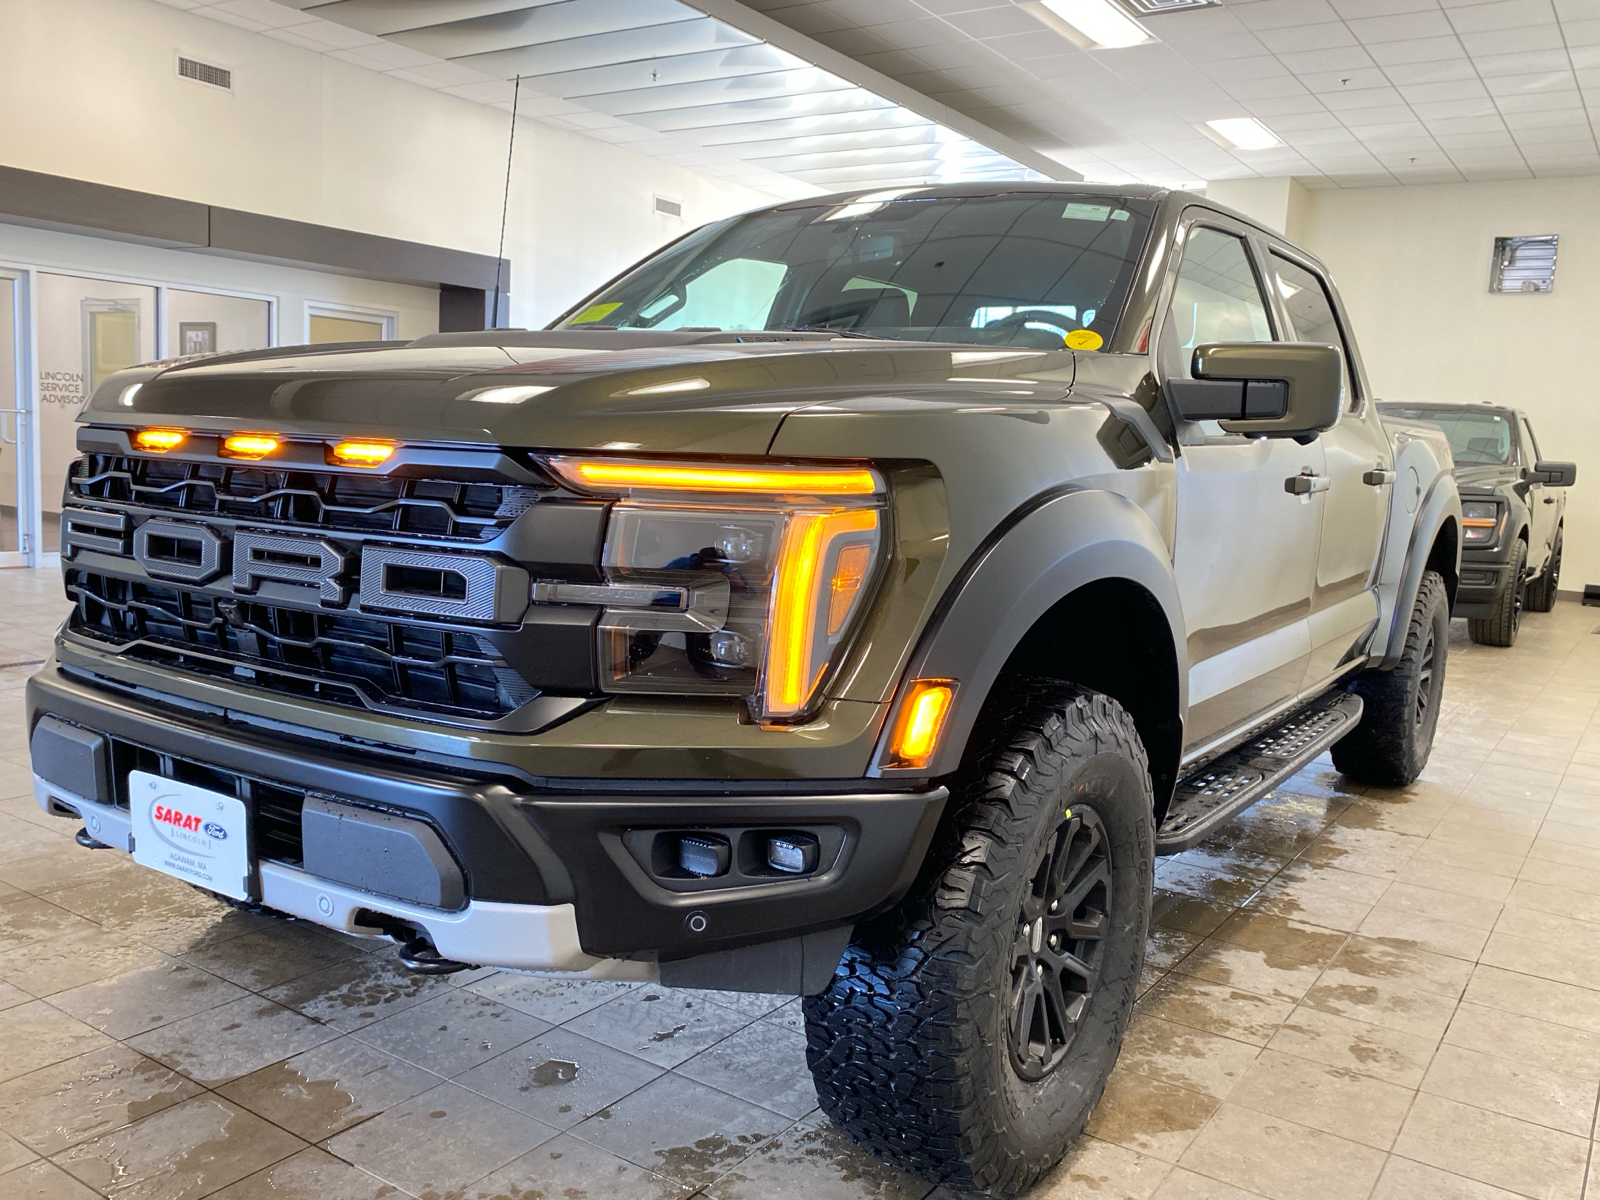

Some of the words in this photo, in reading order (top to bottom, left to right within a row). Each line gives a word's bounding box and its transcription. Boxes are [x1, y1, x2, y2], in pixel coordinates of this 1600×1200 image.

[40, 371, 83, 382] LINCOLN
[40, 382, 80, 393] SERVICE
[60, 505, 502, 622] FORD
[154, 805, 202, 833] SARAT
[175, 829, 207, 846] LINCOLN
[205, 824, 226, 840] Ford
[164, 859, 213, 882] WWW.SARATFORD.COM
[197, 861, 207, 871] MA
